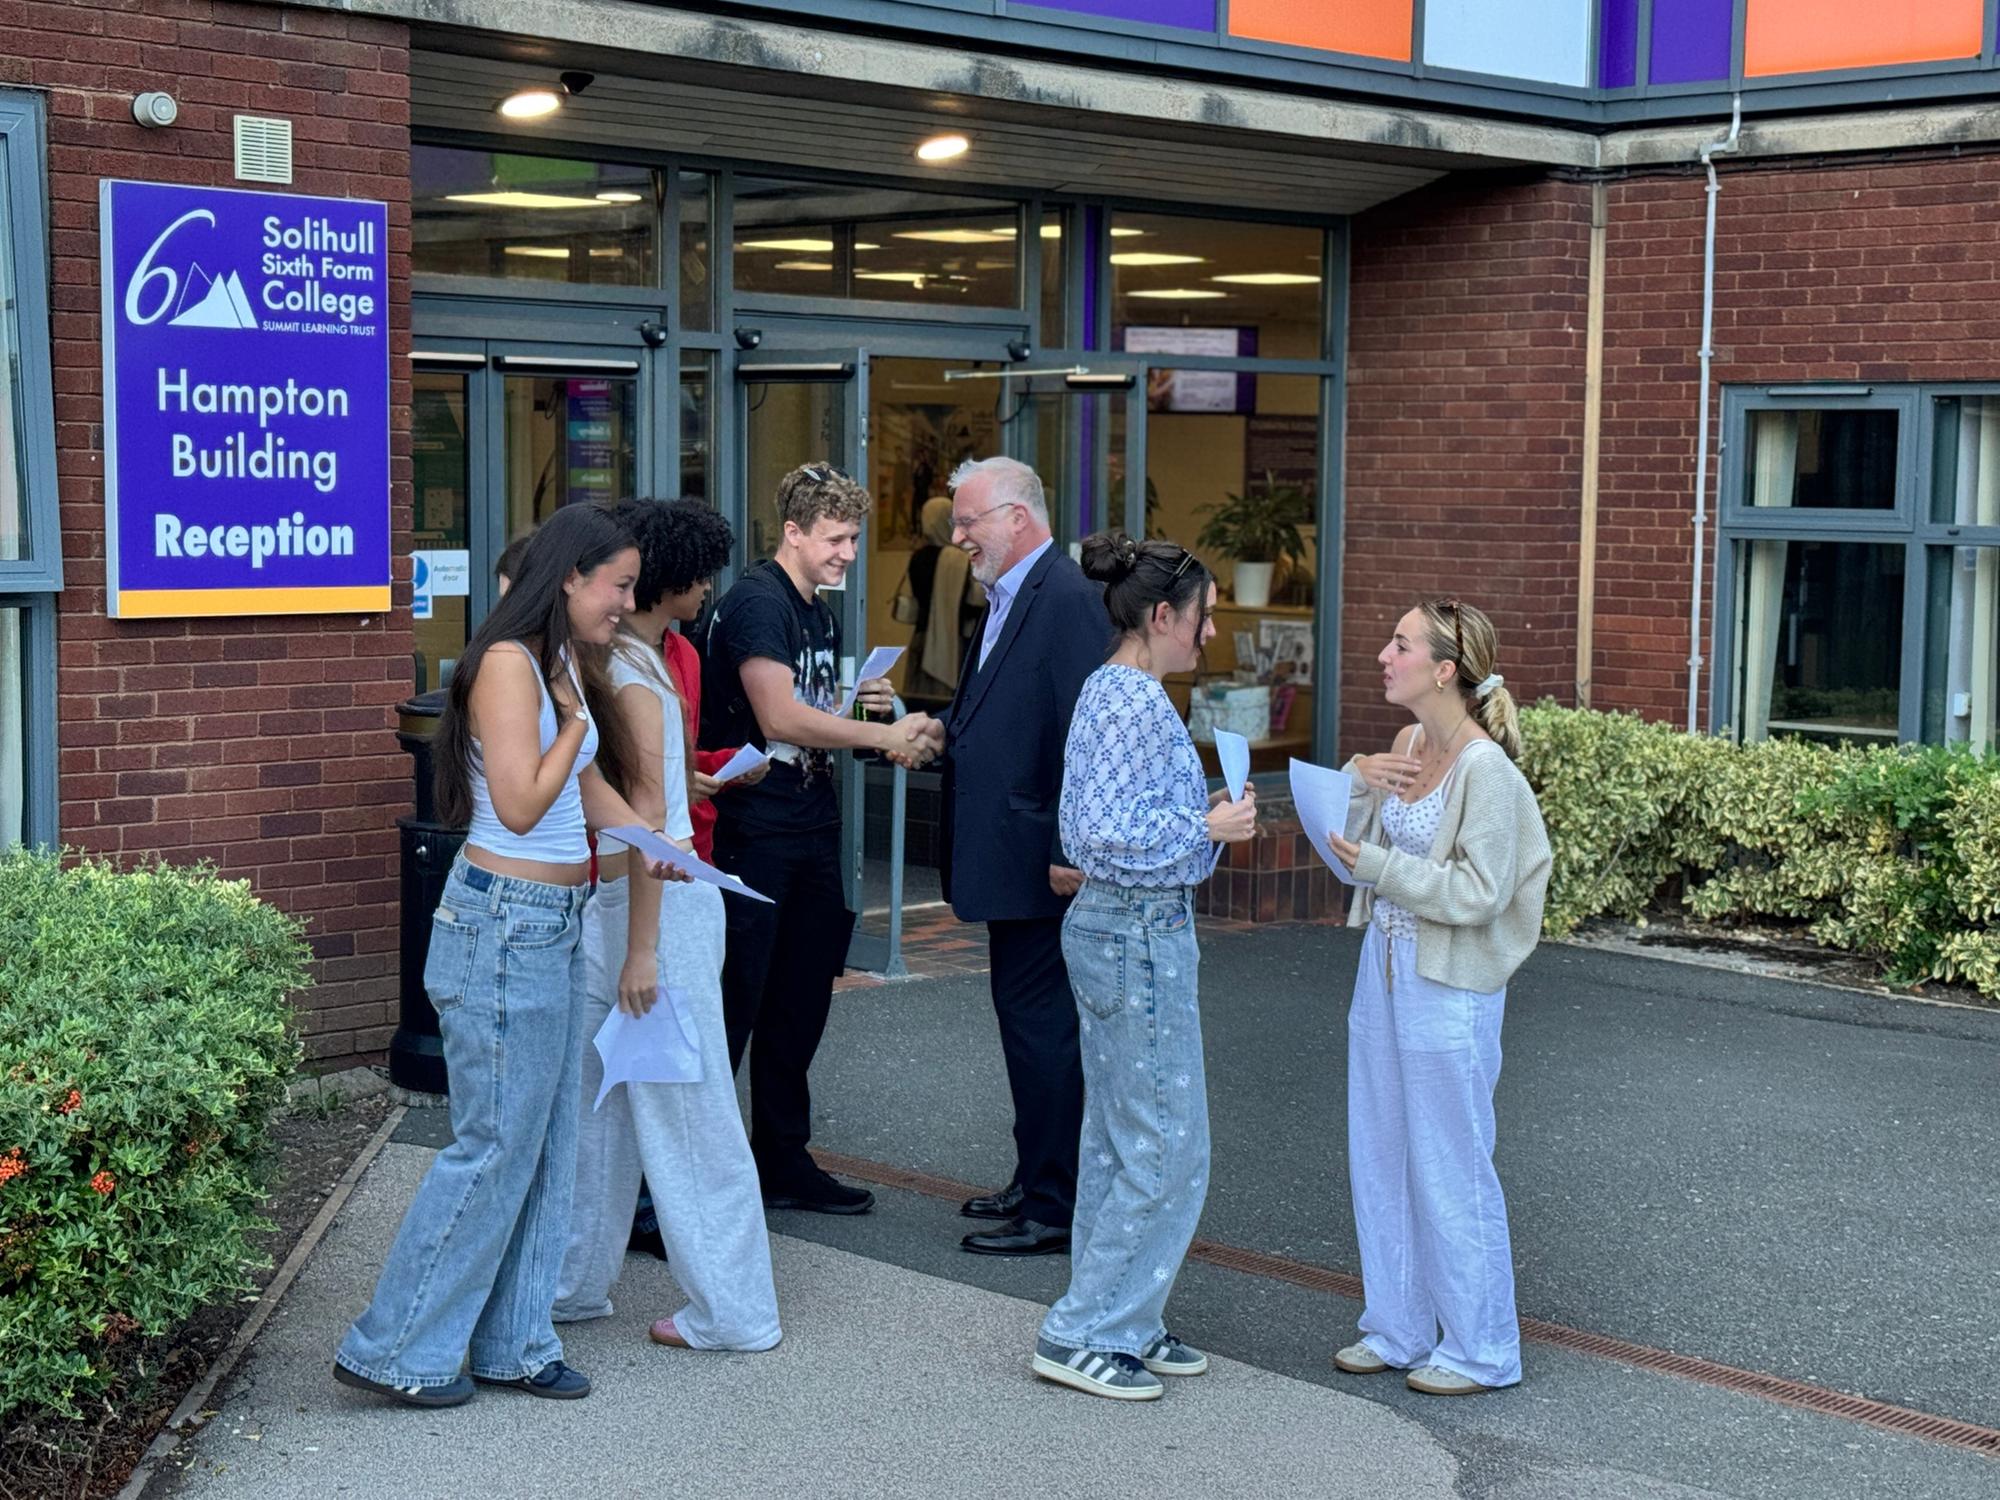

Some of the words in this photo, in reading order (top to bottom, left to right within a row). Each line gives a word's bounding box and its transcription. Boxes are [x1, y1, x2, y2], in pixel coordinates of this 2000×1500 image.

[263, 216, 374, 254] Solihull
[262, 253, 314, 277] Sixth
[322, 257, 373, 280] Form
[263, 280, 374, 322] College
[263, 321, 300, 332] SUMMIT
[301, 323, 348, 335] LEARNING
[350, 325, 375, 336] TRUST
[158, 368, 348, 427] Hampton
[173, 432, 336, 492] Building
[155, 512, 353, 568] Reception
